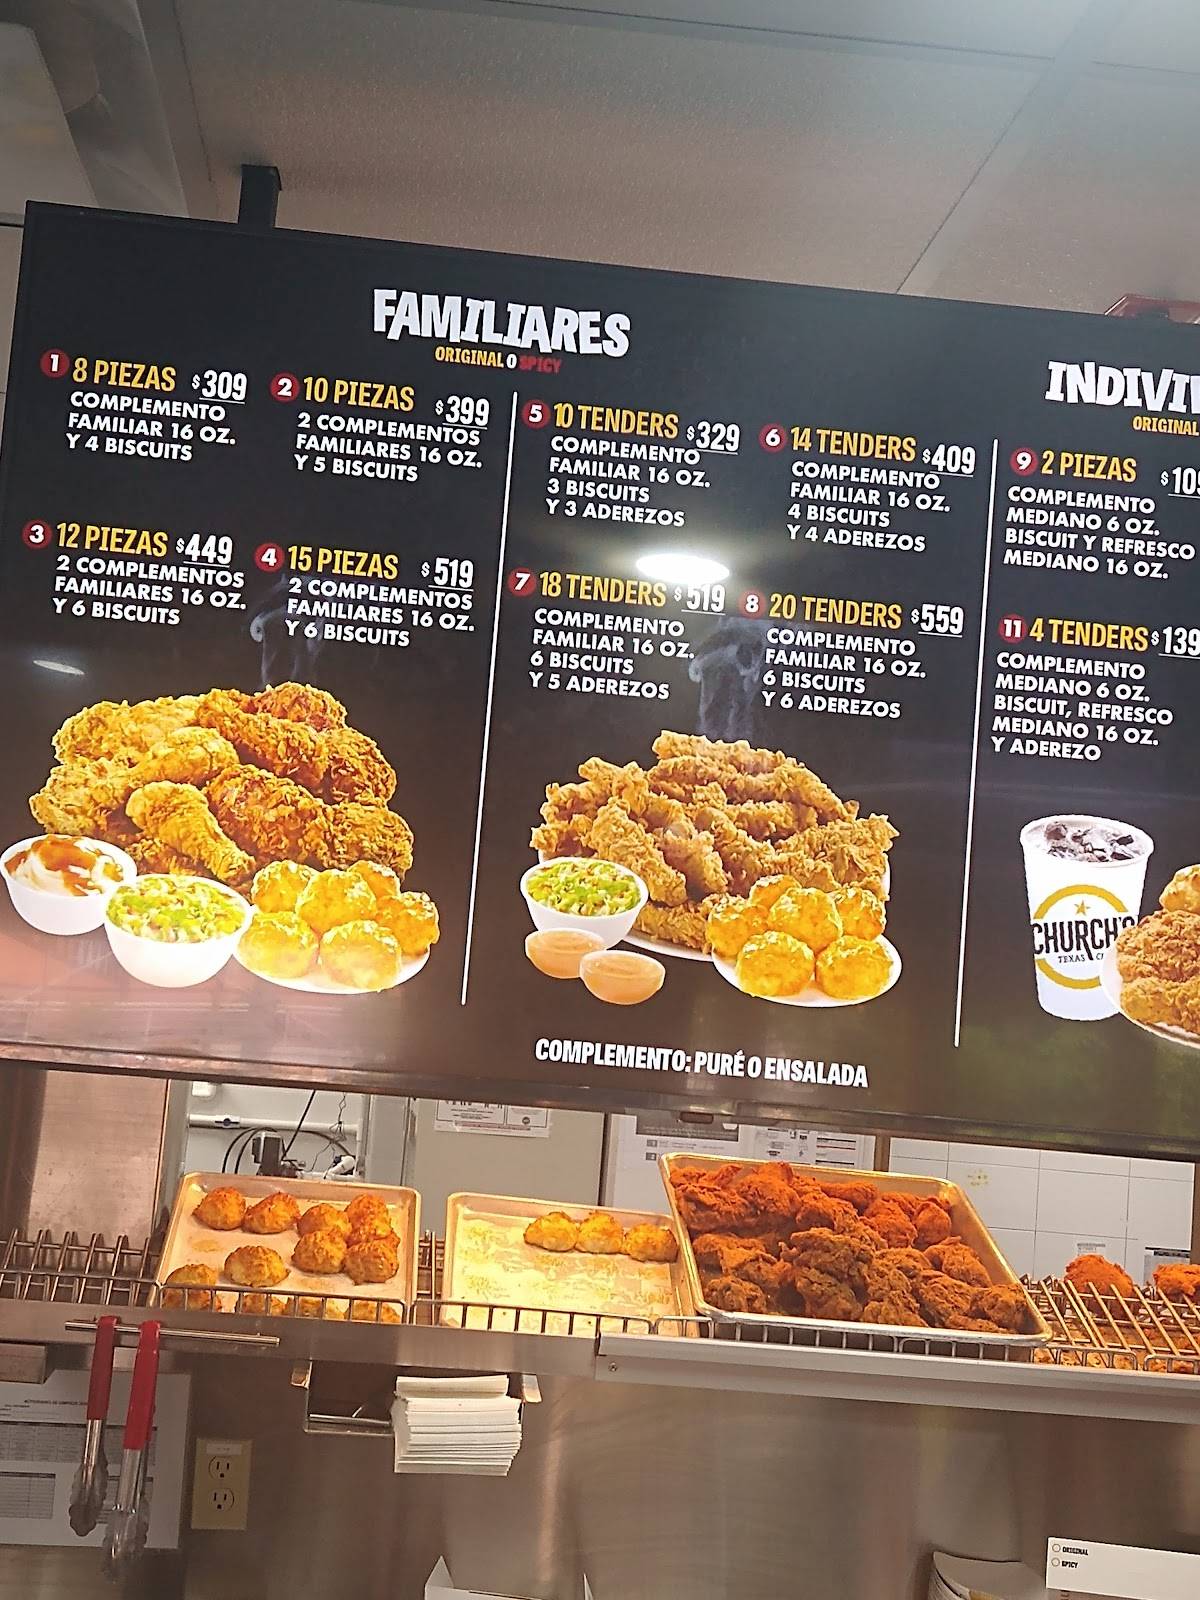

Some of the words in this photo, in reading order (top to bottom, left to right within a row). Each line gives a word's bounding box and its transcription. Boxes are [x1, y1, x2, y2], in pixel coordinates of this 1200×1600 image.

[374, 289, 630, 361] FAMILIARES
[51, 354, 58, 371] 1
[435, 347, 504, 367] ORIGINAL
[507, 354, 517, 368] O
[73, 358, 87, 382] 8
[94, 360, 175, 391] PIEZAS
[278, 378, 292, 396] 2
[69, 389, 227, 423] COMPLEMENTO
[304, 377, 328, 402] 10
[334, 380, 414, 411] PIEZAS
[529, 405, 542, 422] 5
[554, 403, 573, 427] 10
[578, 405, 678, 438] TENDERS
[1133, 416, 1199, 436] ORIGINAL
[66, 413, 162, 440] FAMILIAR
[172, 423, 193, 440] 16
[200, 426, 235, 444] OZ.
[298, 412, 310, 428] 2
[317, 414, 481, 447] COMPLEMENTOS
[766, 429, 780, 446] 6
[66, 433, 80, 448] Y
[85, 436, 98, 451] 4
[105, 437, 192, 460] BISCUITS
[295, 432, 412, 461] FAMILIARES
[420, 446, 441, 463] 16
[447, 450, 481, 468] OZ.
[550, 434, 702, 467] COMPLEMENTO
[791, 427, 811, 451] 14
[817, 429, 916, 461] TENDERS
[294, 454, 308, 470] Y
[314, 457, 325, 472] 5
[332, 458, 417, 481] BISCUITS
[549, 457, 640, 483] FAMILIAR
[649, 467, 669, 483] 16
[676, 470, 710, 487] OZ.
[791, 459, 941, 491] COMPLEMENTO
[1017, 452, 1031, 469] 9
[1042, 451, 1054, 474] 2
[1060, 453, 1136, 482] PIEZAS
[548, 478, 559, 493] 3
[566, 480, 649, 502] BISCUITS
[790, 482, 880, 508] FAMILIAR
[889, 492, 909, 507] 16
[916, 494, 950, 511] OZ.
[1007, 486, 1155, 515] COMPLEMENTO
[546, 498, 560, 514] Y
[565, 501, 576, 516] 3
[583, 503, 684, 526] ADEREZOS
[788, 504, 800, 518] 4
[807, 505, 889, 527] BISCUITS
[1006, 507, 1101, 532] MEDIANO
[1107, 517, 1119, 531] 6
[1125, 518, 1159, 535] OZ.
[30, 525, 44, 543] 3
[57, 523, 80, 548] 12
[85, 526, 168, 557] PIEZAS
[787, 524, 800, 539] Y
[805, 527, 818, 541] 4
[823, 528, 925, 551] ADEREZOS
[1006, 528, 1078, 548] BISCUIT
[1083, 535, 1096, 550] Y
[1102, 537, 1195, 562] REFRESCO
[57, 555, 69, 571] 2
[77, 556, 244, 589] COMPLEMENTOS
[261, 549, 276, 566] 4
[289, 546, 312, 571] 15
[317, 548, 398, 579] PIEZAS
[1004, 549, 1099, 572] MEDIANO
[1107, 559, 1128, 574] 16
[1134, 561, 1168, 578] OZ.
[54, 575, 173, 603] FAMILIARES
[182, 588, 204, 605] 16
[210, 591, 246, 609] OZ.
[289, 578, 302, 593] 2
[308, 578, 473, 611] COMPLEMENTOS
[515, 573, 530, 590] 7
[540, 572, 561, 596] 18
[566, 572, 668, 607] TENDERS
[53, 598, 67, 613] Y
[72, 600, 85, 615] 6
[92, 602, 180, 624] BISCUITS
[286, 598, 403, 626] FAMILIARES
[412, 610, 433, 627] 16
[439, 613, 474, 631] OZ.
[746, 595, 758, 612] 8
[769, 594, 796, 619] 20
[802, 597, 901, 628] TENDERS
[285, 620, 300, 635] Y
[304, 623, 317, 638] 6
[324, 624, 409, 646] BISCUITS
[533, 608, 686, 639] COMPLEMENTO
[1004, 620, 1021, 637] 11
[1030, 618, 1044, 641] 4
[1049, 619, 1148, 651] TENDERS
[532, 629, 624, 655] FAMILIAR
[633, 638, 653, 654] 16
[660, 641, 694, 658] OZ.
[766, 628, 915, 658] COMPLEMENTO
[531, 651, 543, 666] 6
[550, 652, 633, 674] BISCUITS
[764, 648, 855, 675] FAMILIAR
[864, 658, 885, 674] 16
[891, 660, 925, 678] OZ.
[996, 652, 1145, 681] COMPLEMENTO
[529, 672, 543, 687] Y
[548, 674, 560, 689] 5
[566, 676, 669, 699] ADEREZOS
[763, 670, 776, 685] 6
[782, 672, 865, 693] BISCUITS
[995, 673, 1091, 699] MEDIANO
[1097, 683, 1109, 698] 6
[1115, 684, 1149, 702] OZ.
[762, 691, 776, 706] Y
[781, 693, 793, 708] 6
[798, 695, 900, 718] ADEREZOS
[994, 695, 1071, 718] BISCUIT,
[1077, 702, 1173, 727] REFRESCO
[991, 716, 1088, 741] MEDIANO
[1097, 725, 1118, 741] 16
[1124, 728, 1158, 745] OZ.
[991, 736, 1005, 752] Y
[1010, 739, 1101, 760] ADEREZO
[1059, 955, 1086, 963] TEXAS
[536, 1039, 691, 1072] COMPLEMENTO:
[694, 1050, 745, 1076] PURÉ
[748, 1058, 761, 1077] O
[765, 1057, 867, 1087] ENSALADA
